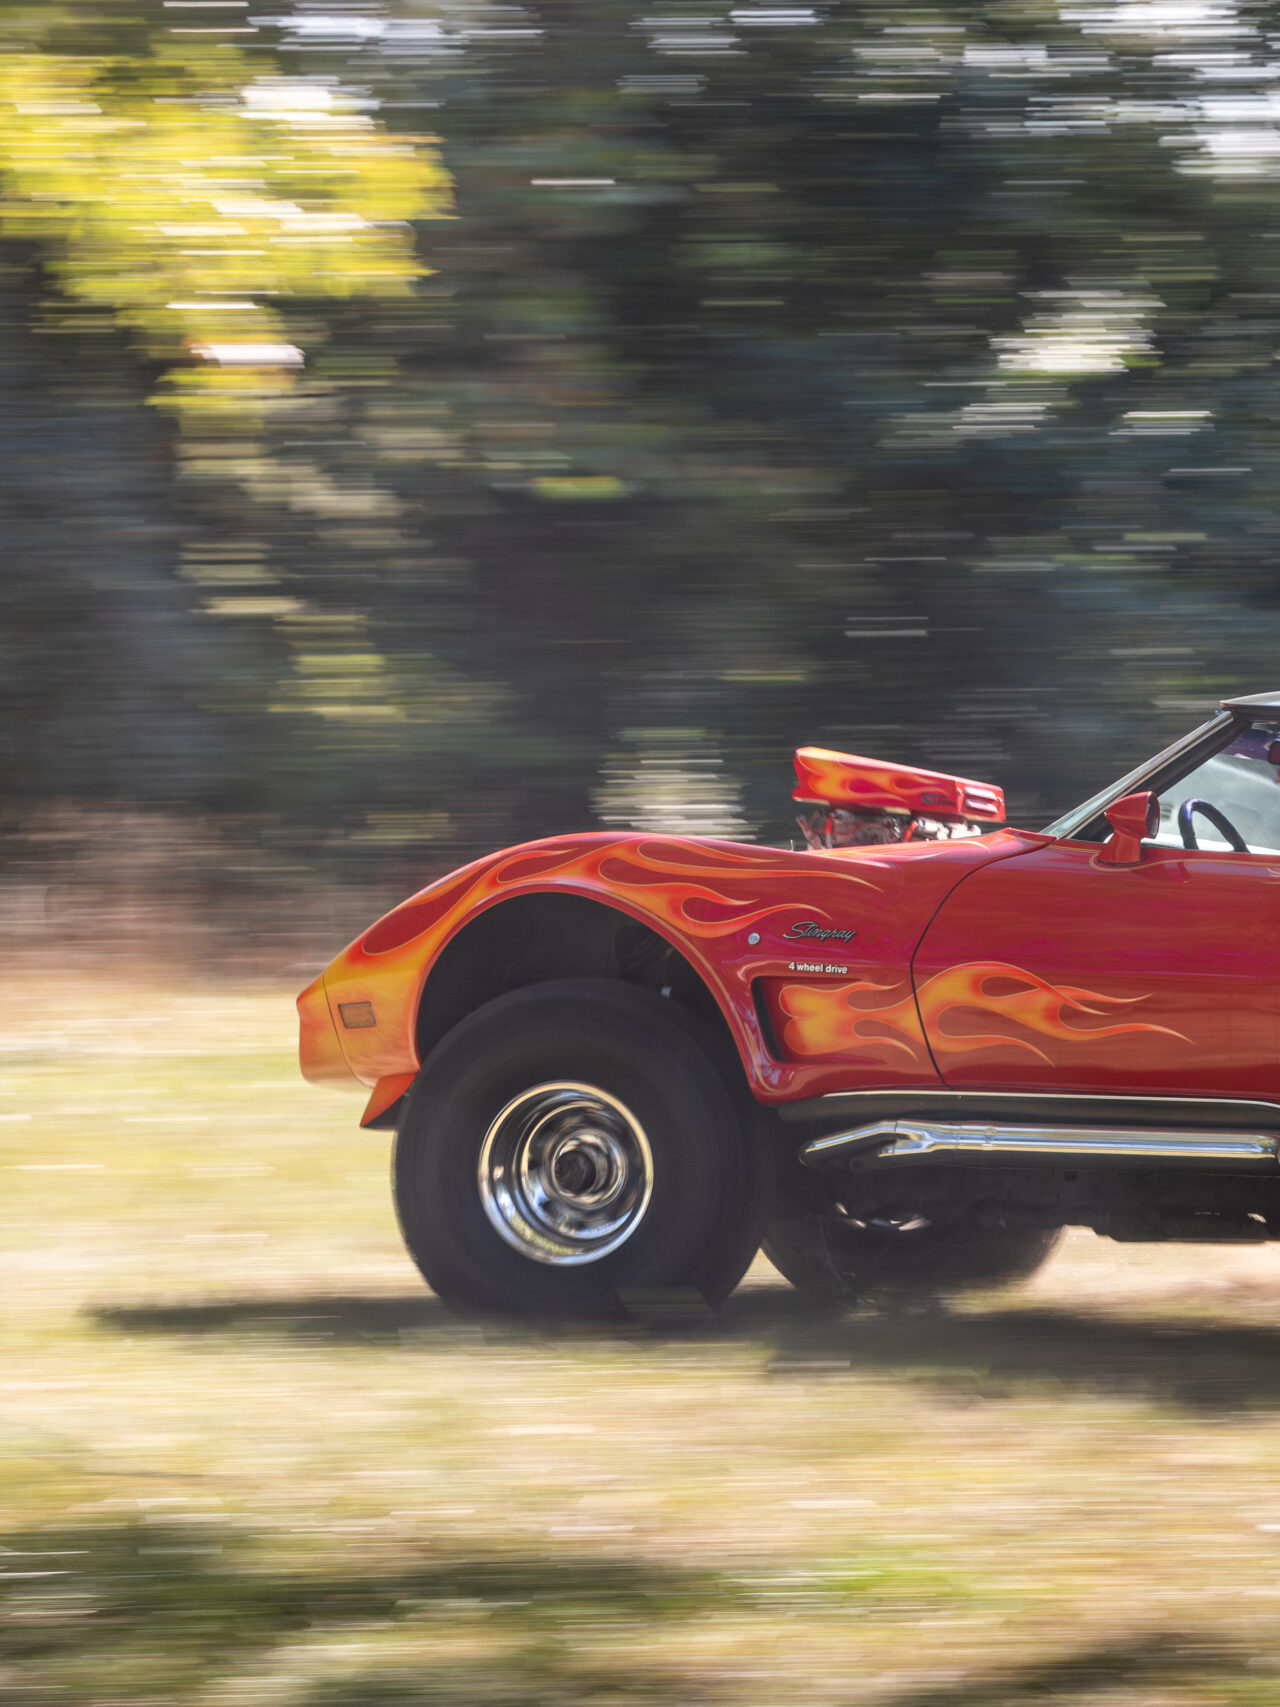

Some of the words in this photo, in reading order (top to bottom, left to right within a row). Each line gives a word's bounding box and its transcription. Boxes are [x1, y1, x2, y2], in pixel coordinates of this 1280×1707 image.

[782, 921, 857, 943] Stingray
[788, 961, 796, 971] 4
[796, 962, 824, 972] wheel
[825, 964, 849, 974] drive
